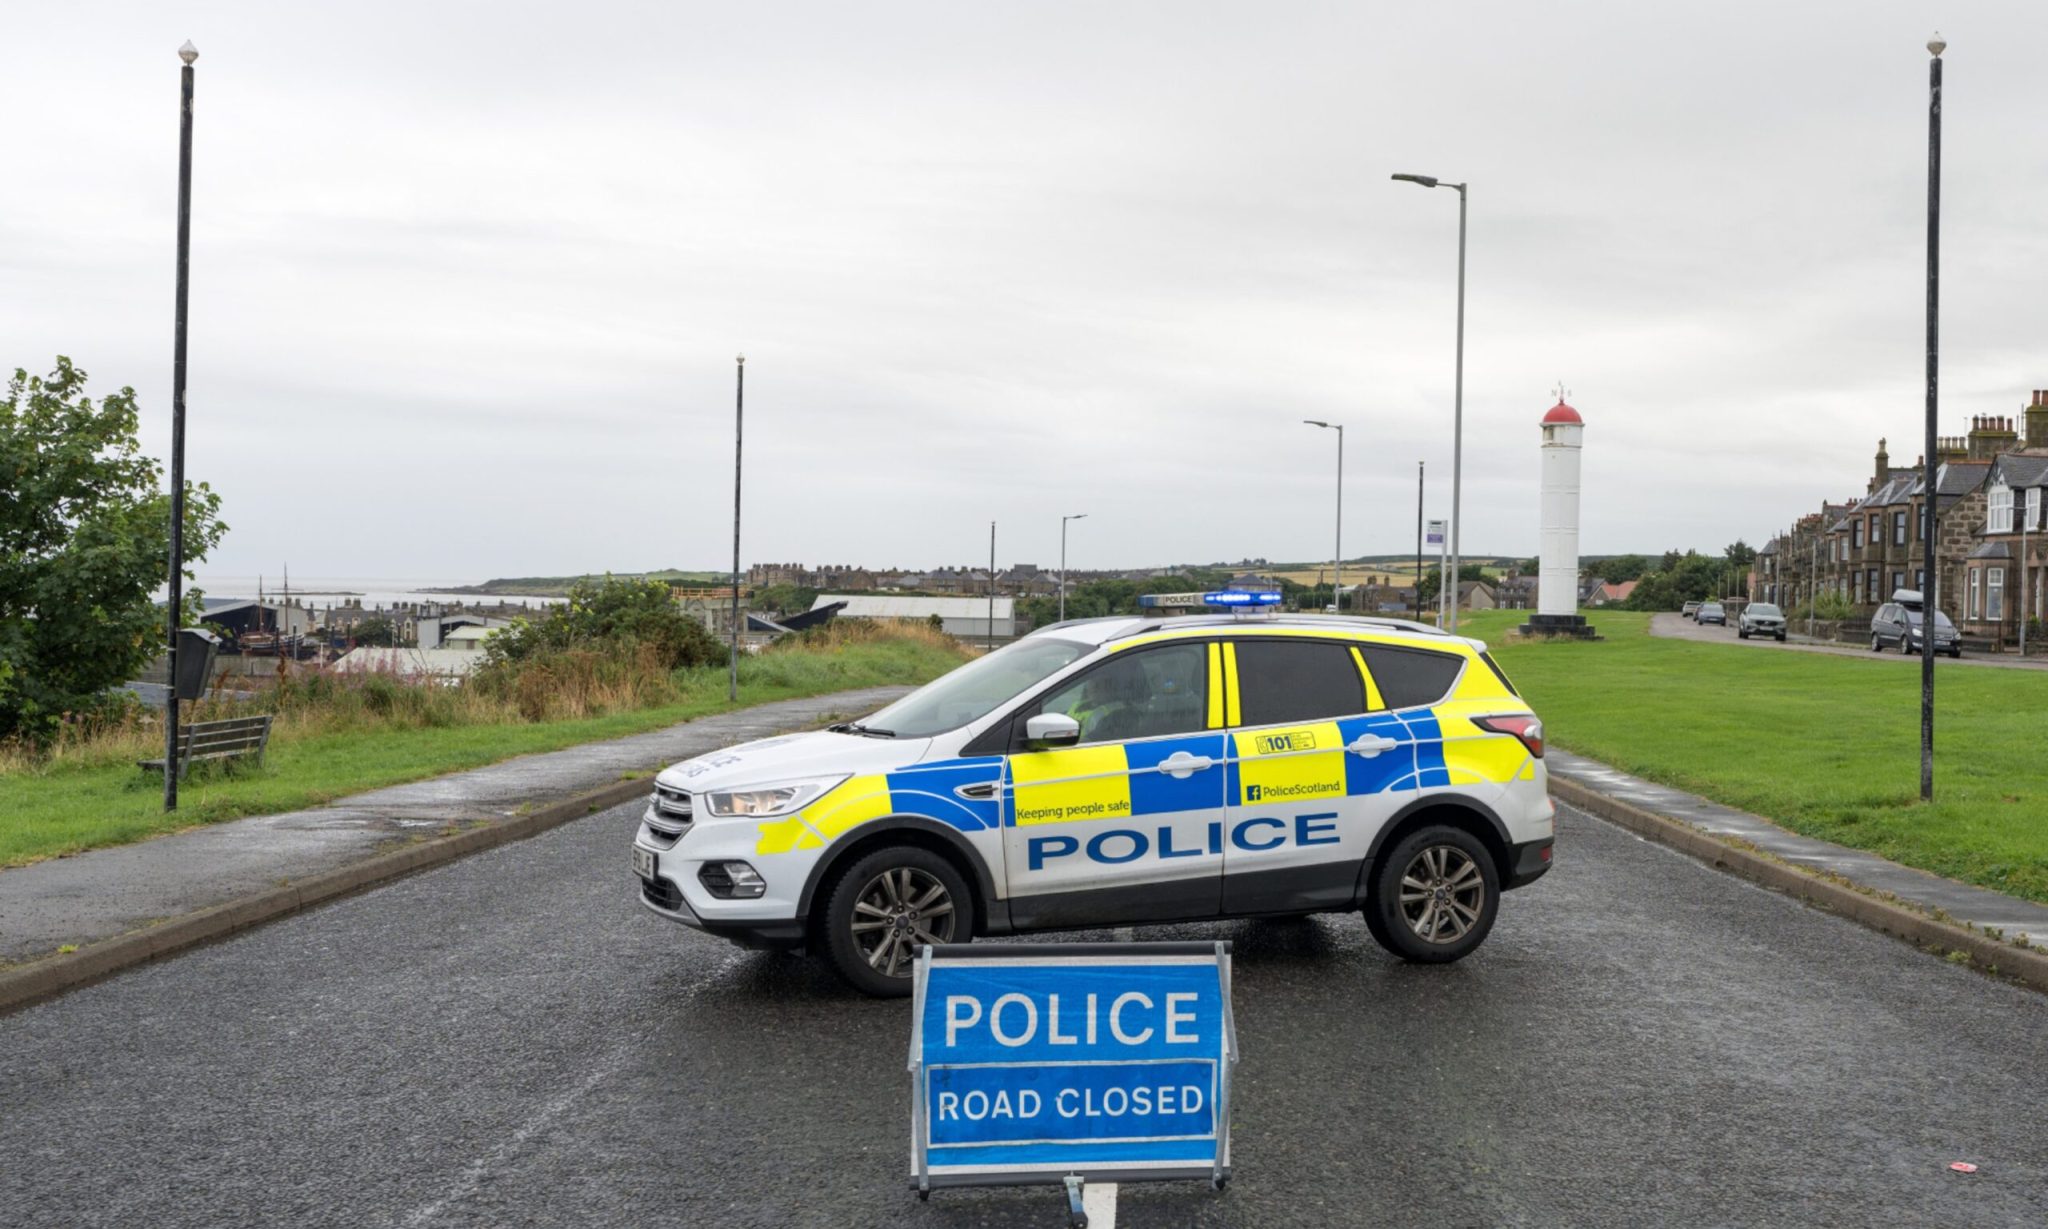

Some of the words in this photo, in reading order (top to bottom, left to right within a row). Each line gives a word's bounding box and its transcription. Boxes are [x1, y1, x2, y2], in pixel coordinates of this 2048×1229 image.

[1165, 595, 1193, 603] POLICE
[1267, 735, 1292, 751] 101
[1263, 781, 1340, 797] PoliceScotland
[1016, 807, 1063, 820] Keeping
[1066, 802, 1104, 818] people
[1107, 800, 1130, 812] safe
[1028, 812, 1341, 871] POLICE
[945, 991, 1199, 1048] POLICE
[938, 1089, 1042, 1121] ROAD
[1055, 1085, 1204, 1119] CLOSED
